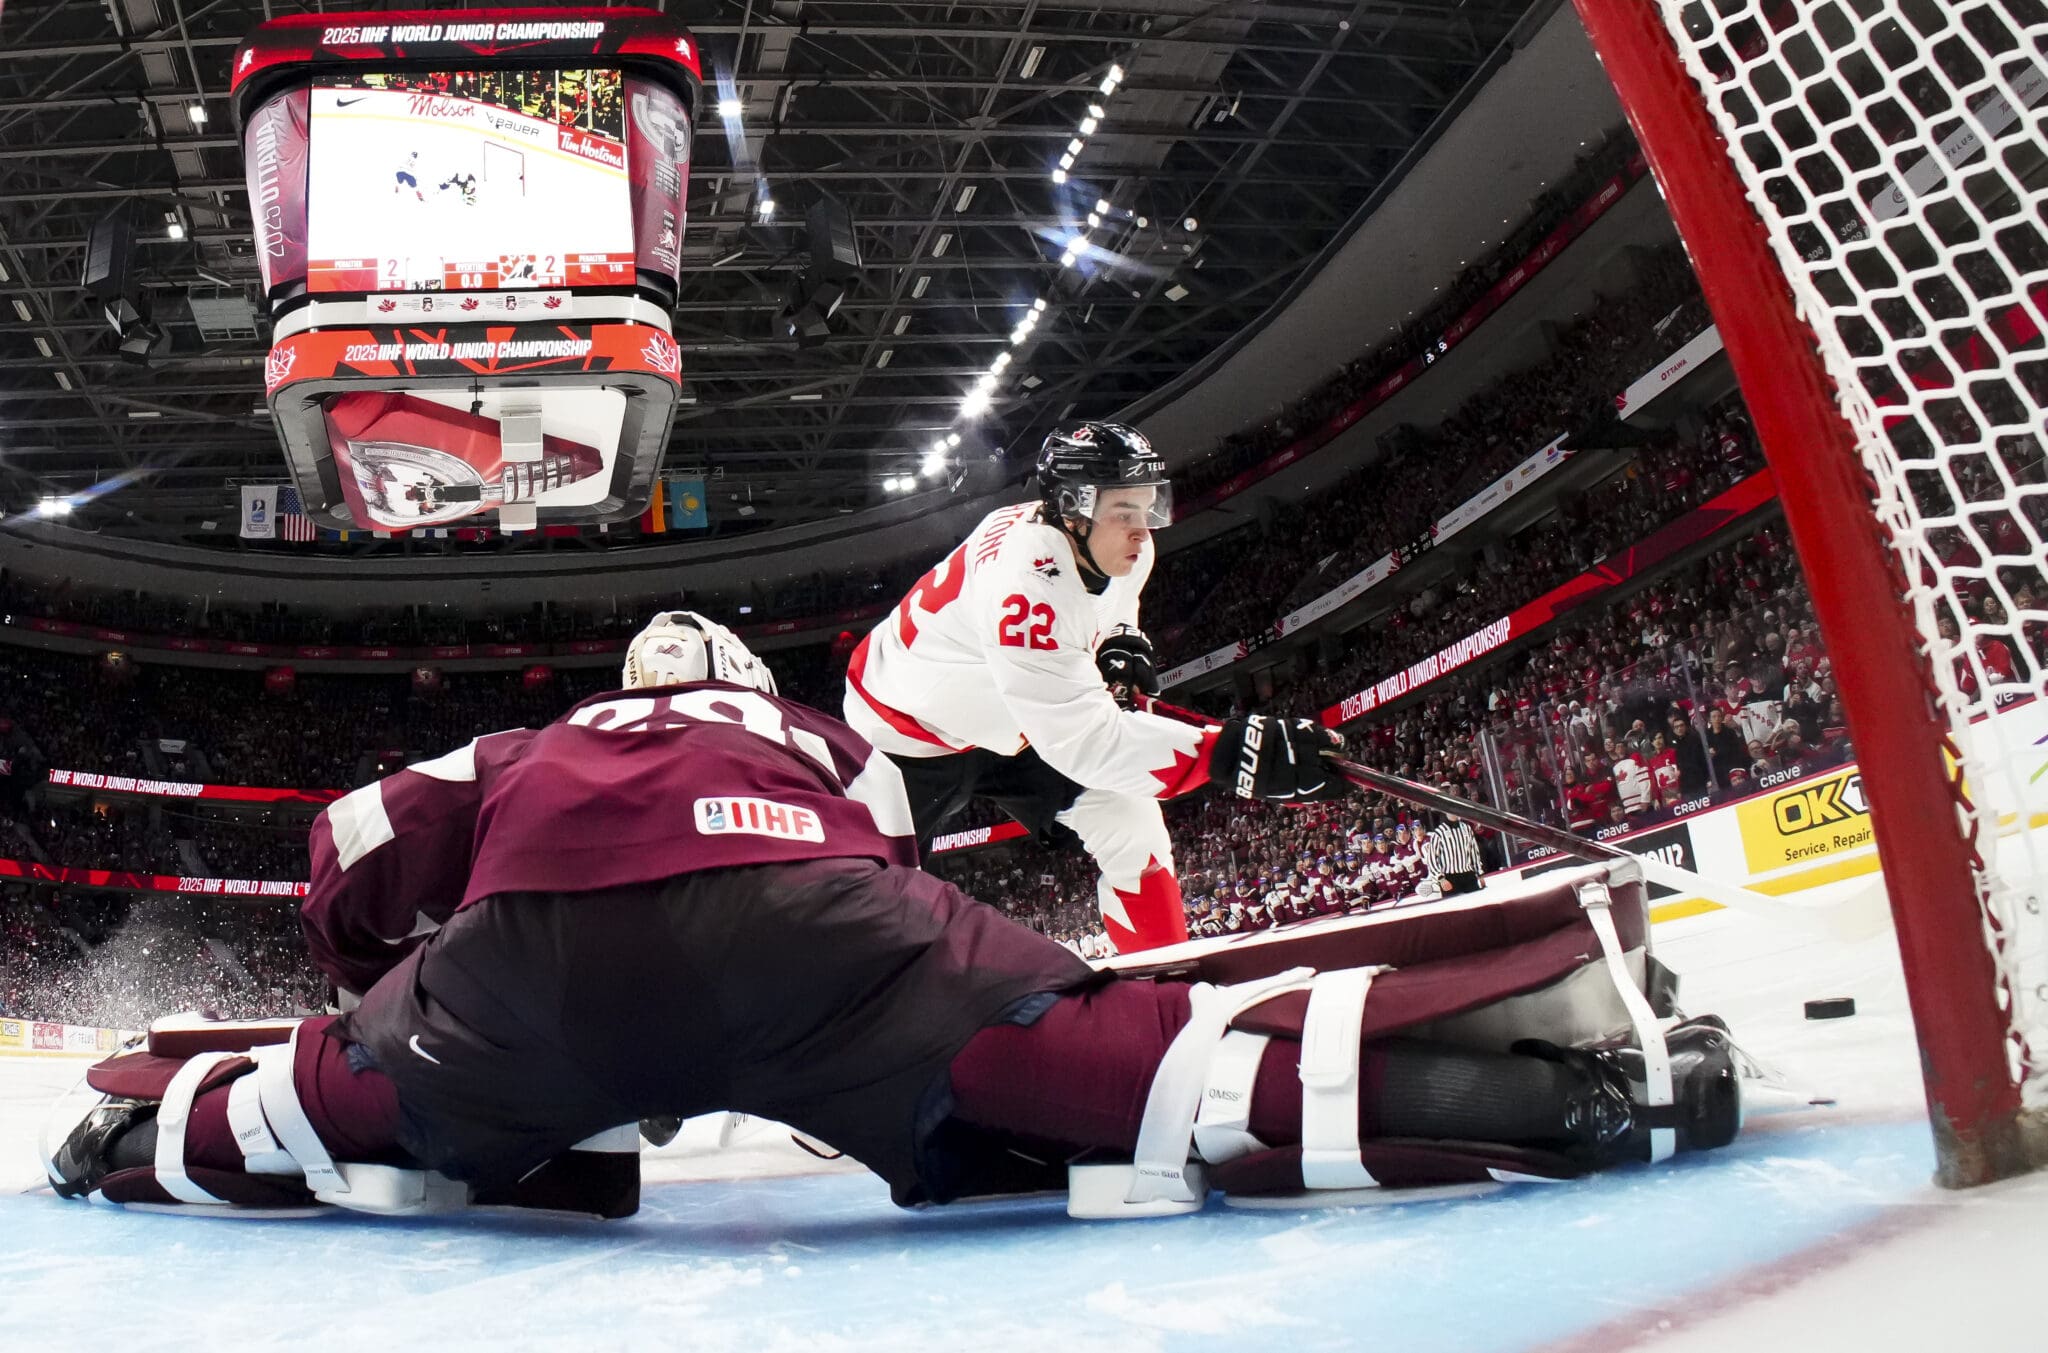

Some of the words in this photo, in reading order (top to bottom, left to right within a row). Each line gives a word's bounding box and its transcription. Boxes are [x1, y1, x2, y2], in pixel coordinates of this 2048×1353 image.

[322, 27, 361, 44] 2025
[360, 26, 390, 43] IIHF
[391, 25, 443, 42] WORLD
[442, 24, 496, 41] JUNIOR
[496, 22, 605, 40] CHAMPIONSHIP
[408, 94, 475, 118] Molson
[256, 120, 279, 206] OTTAWA
[559, 130, 580, 153] Tim
[579, 137, 624, 168] Hortons
[266, 206, 285, 257] 2025
[387, 259, 398, 277] 2
[545, 255, 556, 273] 2
[345, 345, 379, 361] 2025
[378, 344, 403, 360] IIHF
[405, 342, 449, 360] WORLD
[450, 341, 495, 359] JUNIOR
[497, 339, 593, 357] CHAMPIONSHIP
[1660, 359, 1688, 381] OTTAWA
[1000, 594, 1059, 650] 22
[1341, 694, 1362, 721] 2025
[1360, 685, 1377, 711] IIHF
[1376, 671, 1407, 704] WORLD
[1408, 654, 1440, 689] JUNIOR
[1439, 616, 1511, 673] CHAMPIONSHIP
[53, 769, 72, 783] IIHF
[72, 772, 104, 788] WORLD
[104, 776, 136, 791] JUNIOR
[136, 780, 204, 797] CHAMPIONSHIP
[731, 801, 813, 835] IIHF
[1774, 780, 1848, 834] OK
[1785, 842, 1830, 861] Service,
[1833, 827, 1872, 849] Repair
[178, 876, 203, 892] 2025
[203, 878, 223, 893] IIHF
[224, 879, 259, 894] WORLD
[259, 881, 292, 896] JUNIOR
